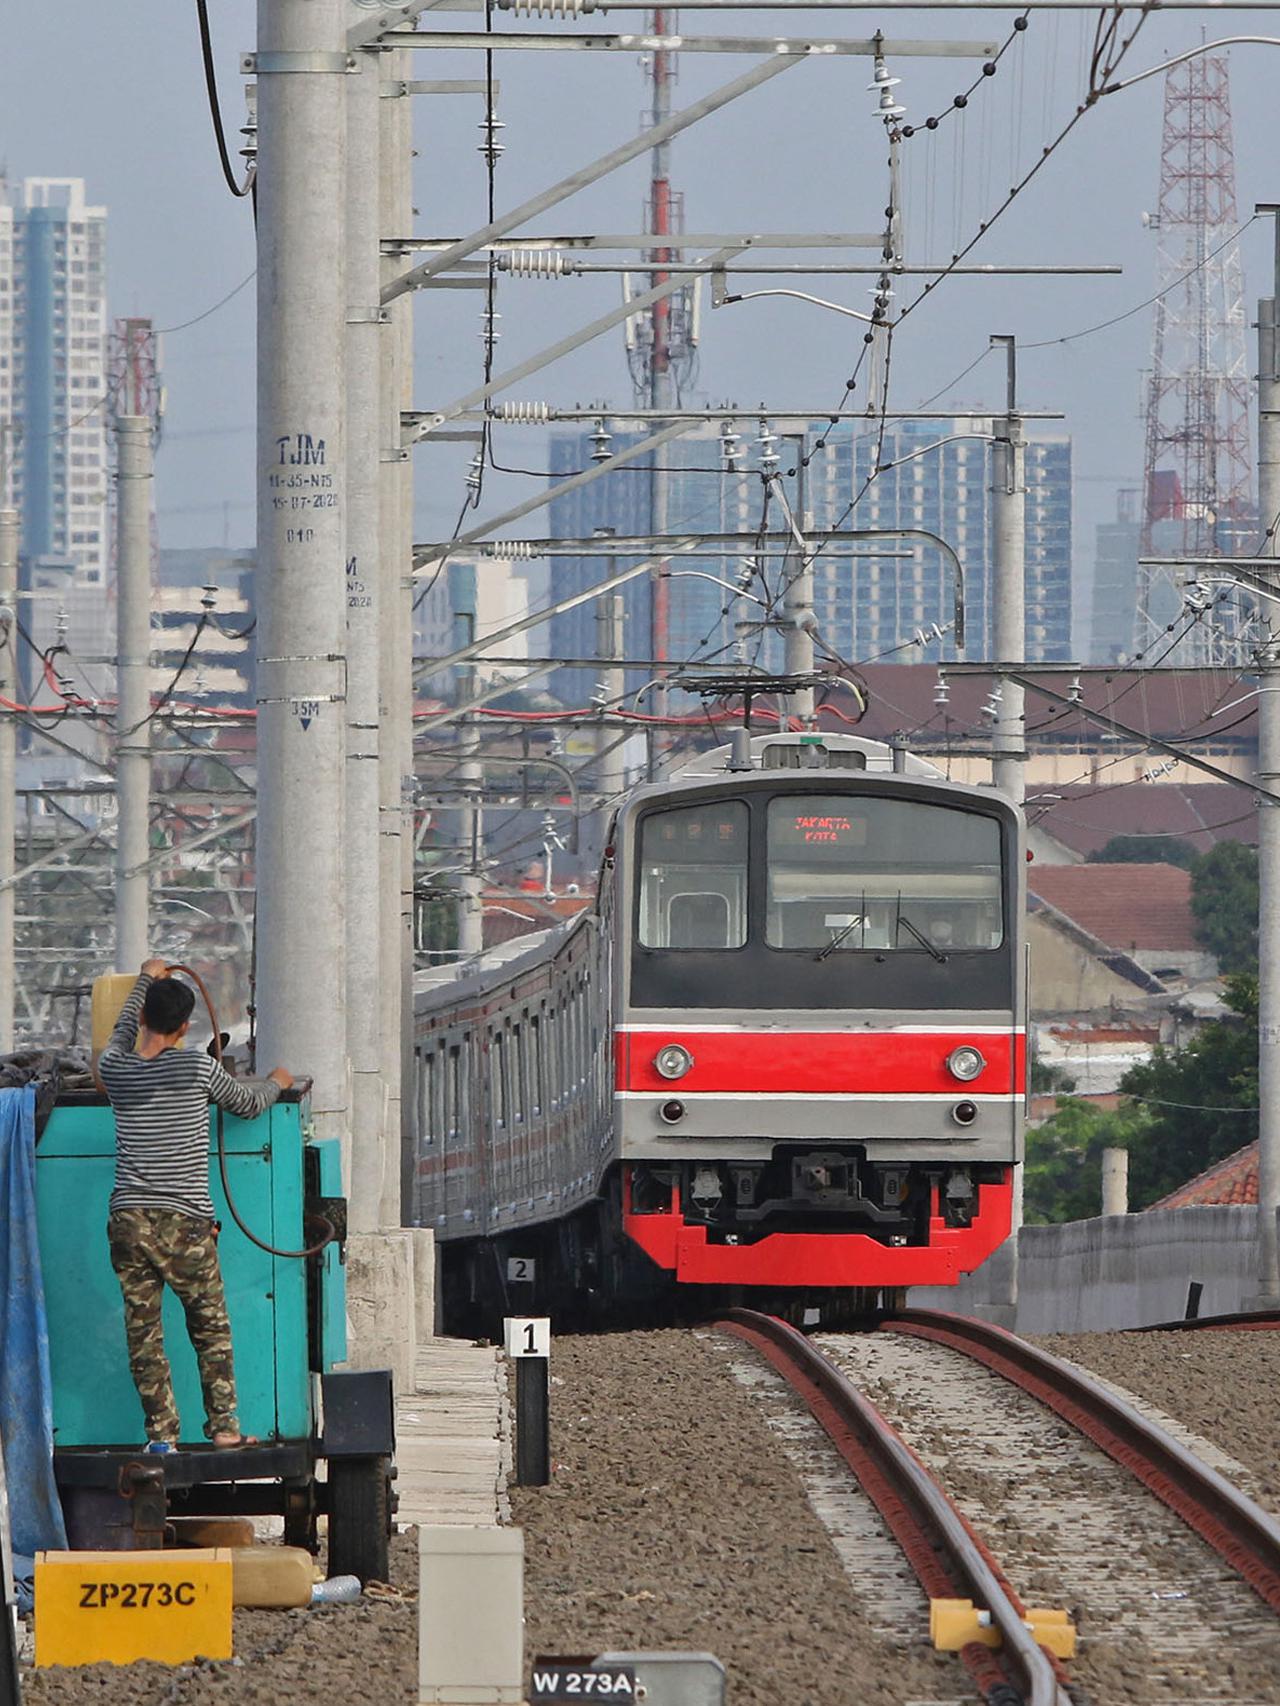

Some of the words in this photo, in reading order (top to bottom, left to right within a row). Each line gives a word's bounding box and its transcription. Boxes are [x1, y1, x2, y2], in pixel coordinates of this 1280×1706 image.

[276, 433, 326, 465] TJM
[291, 700, 319, 716] 35M
[515, 1260, 527, 1278] 2
[523, 1323, 538, 1354] 1
[79, 1582, 196, 1608] ZP273C
[533, 1672, 559, 1693] W
[565, 1672, 633, 1694] 273A
